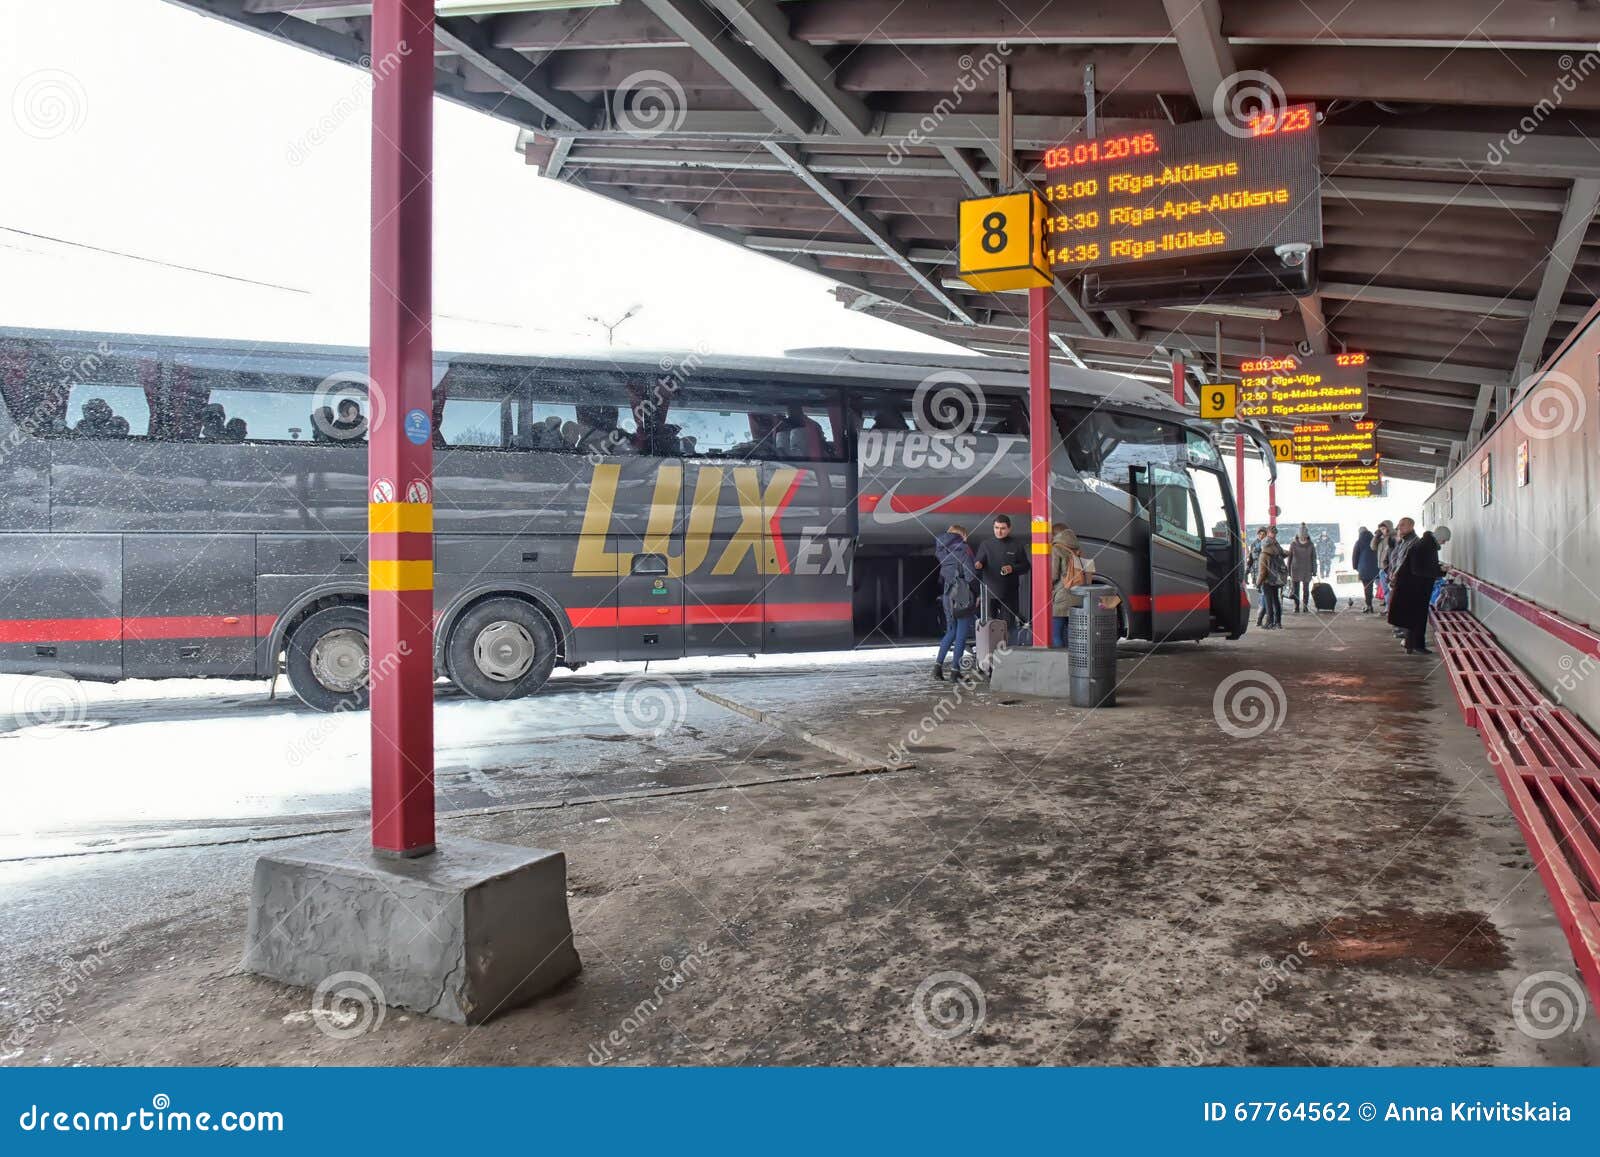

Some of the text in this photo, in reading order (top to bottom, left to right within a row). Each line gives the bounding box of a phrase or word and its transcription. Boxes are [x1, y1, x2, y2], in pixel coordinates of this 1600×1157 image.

[1044, 133, 1159, 169] 03.01.2016.
[1045, 180, 1099, 202] 13:00
[981, 211, 1009, 254] 8
[1046, 212, 1100, 234] 13:30
[1047, 243, 1101, 266] 14:35
[1211, 391, 1226, 411] 9
[1272, 443, 1289, 457] 10
[1303, 469, 1316, 478] 11
[572, 464, 806, 578] LUX
